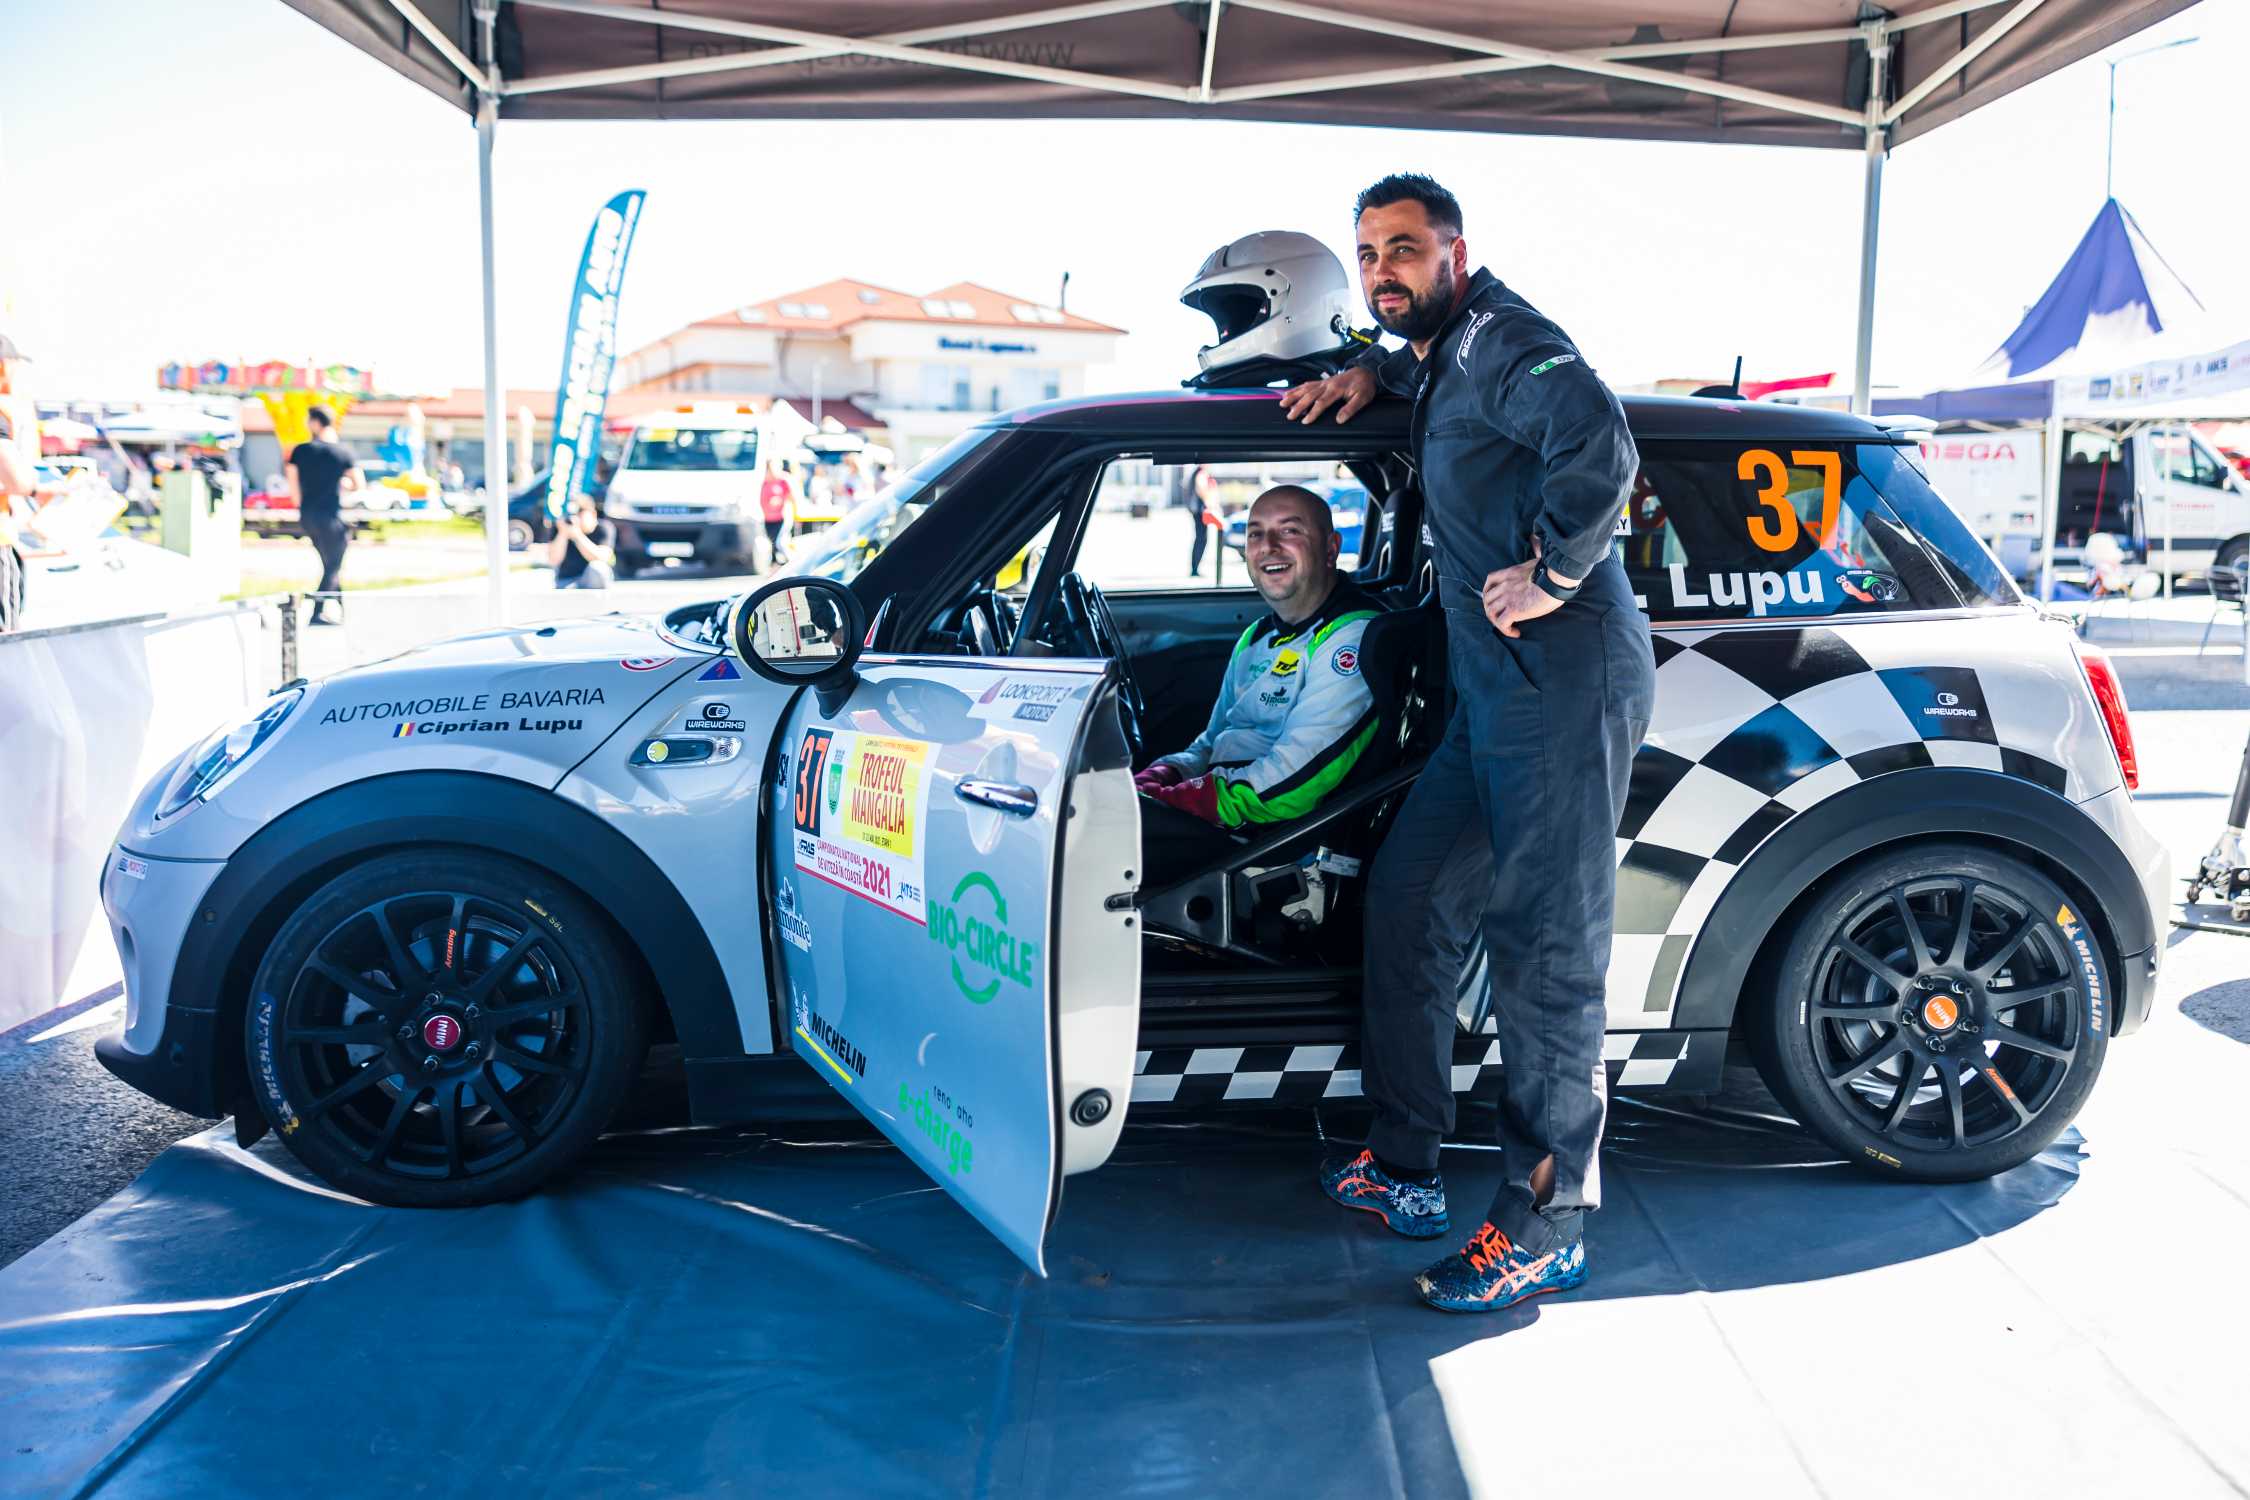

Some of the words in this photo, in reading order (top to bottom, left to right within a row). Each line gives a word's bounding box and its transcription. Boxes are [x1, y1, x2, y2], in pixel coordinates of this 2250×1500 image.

[1461, 312, 1495, 359] sparco
[1737, 449, 1841, 552] 37
[1669, 563, 1824, 616] Lupu
[320, 694, 490, 726] AUTOMOBILE
[499, 687, 606, 709] BAVARIA
[416, 718, 510, 737] Ciprian
[518, 717, 583, 735] Lupu
[687, 720, 745, 729] WIREWORKS
[1923, 707, 1977, 717] WIREWORKS
[795, 734, 830, 829] 37
[860, 752, 907, 795] TROFEUL
[852, 787, 905, 835] MANGALIA
[862, 857, 891, 899] 2021
[928, 899, 1033, 989] BIO-CIRCLE
[2074, 939, 2103, 1032] MICHELIN
[435, 1019, 449, 1046] MINI
[811, 1011, 867, 1079] MICHELIN
[898, 1081, 973, 1179] e-charge
